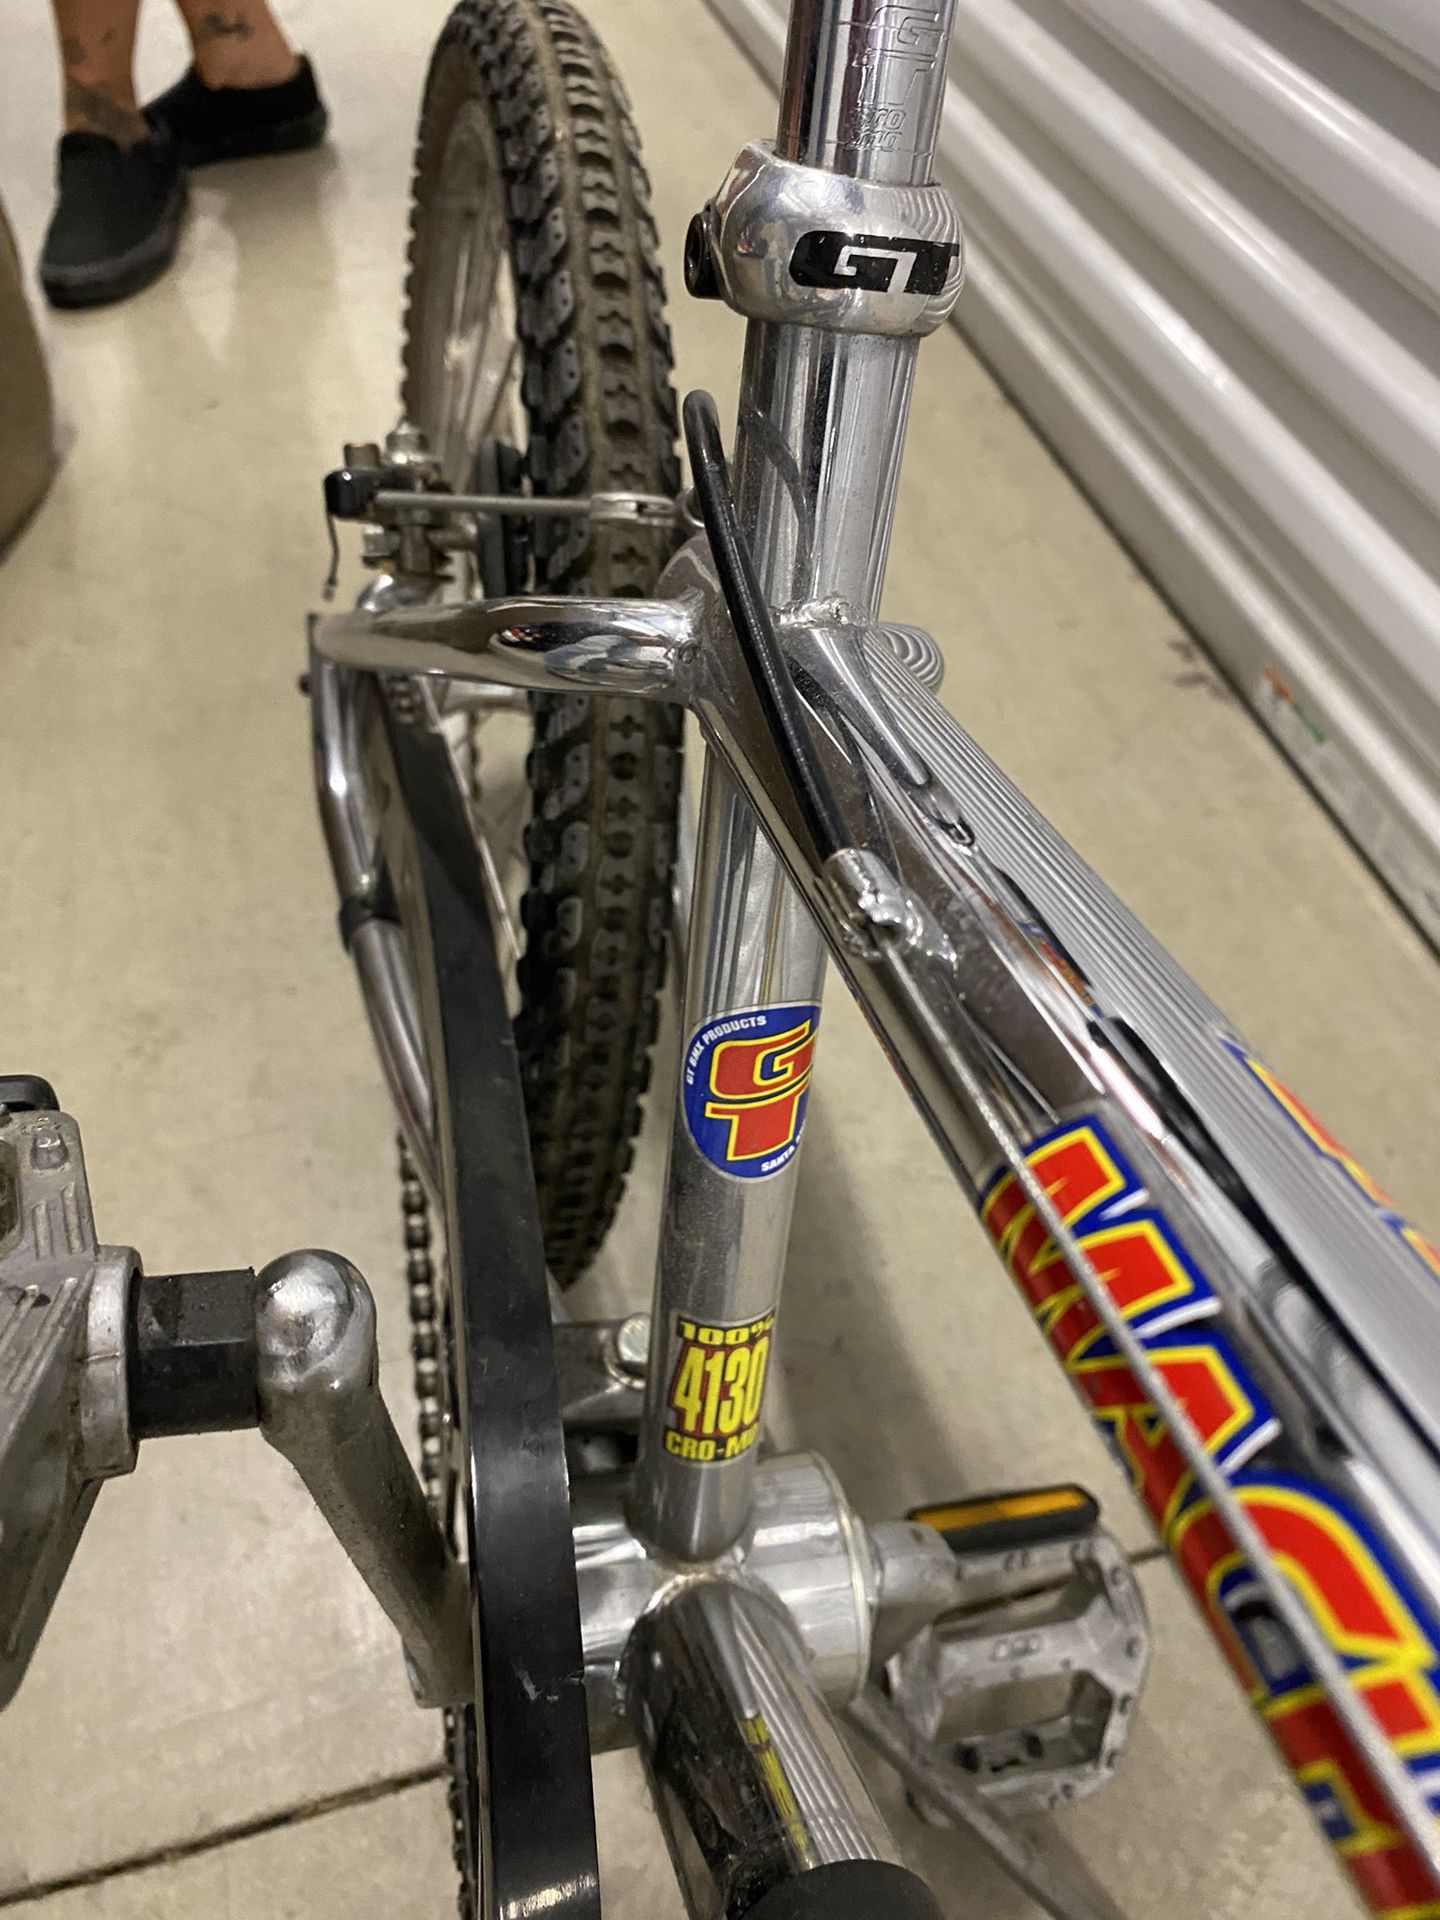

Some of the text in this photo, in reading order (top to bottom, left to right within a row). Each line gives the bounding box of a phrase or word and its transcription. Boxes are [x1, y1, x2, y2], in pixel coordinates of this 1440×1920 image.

[686, 1015, 767, 1085] GT BMX PRODUCTS
[705, 1019, 819, 1161] GT
[761, 1145, 795, 1172] SANTA
[679, 1314, 774, 1346] 100%
[674, 1336, 769, 1434] 4130
